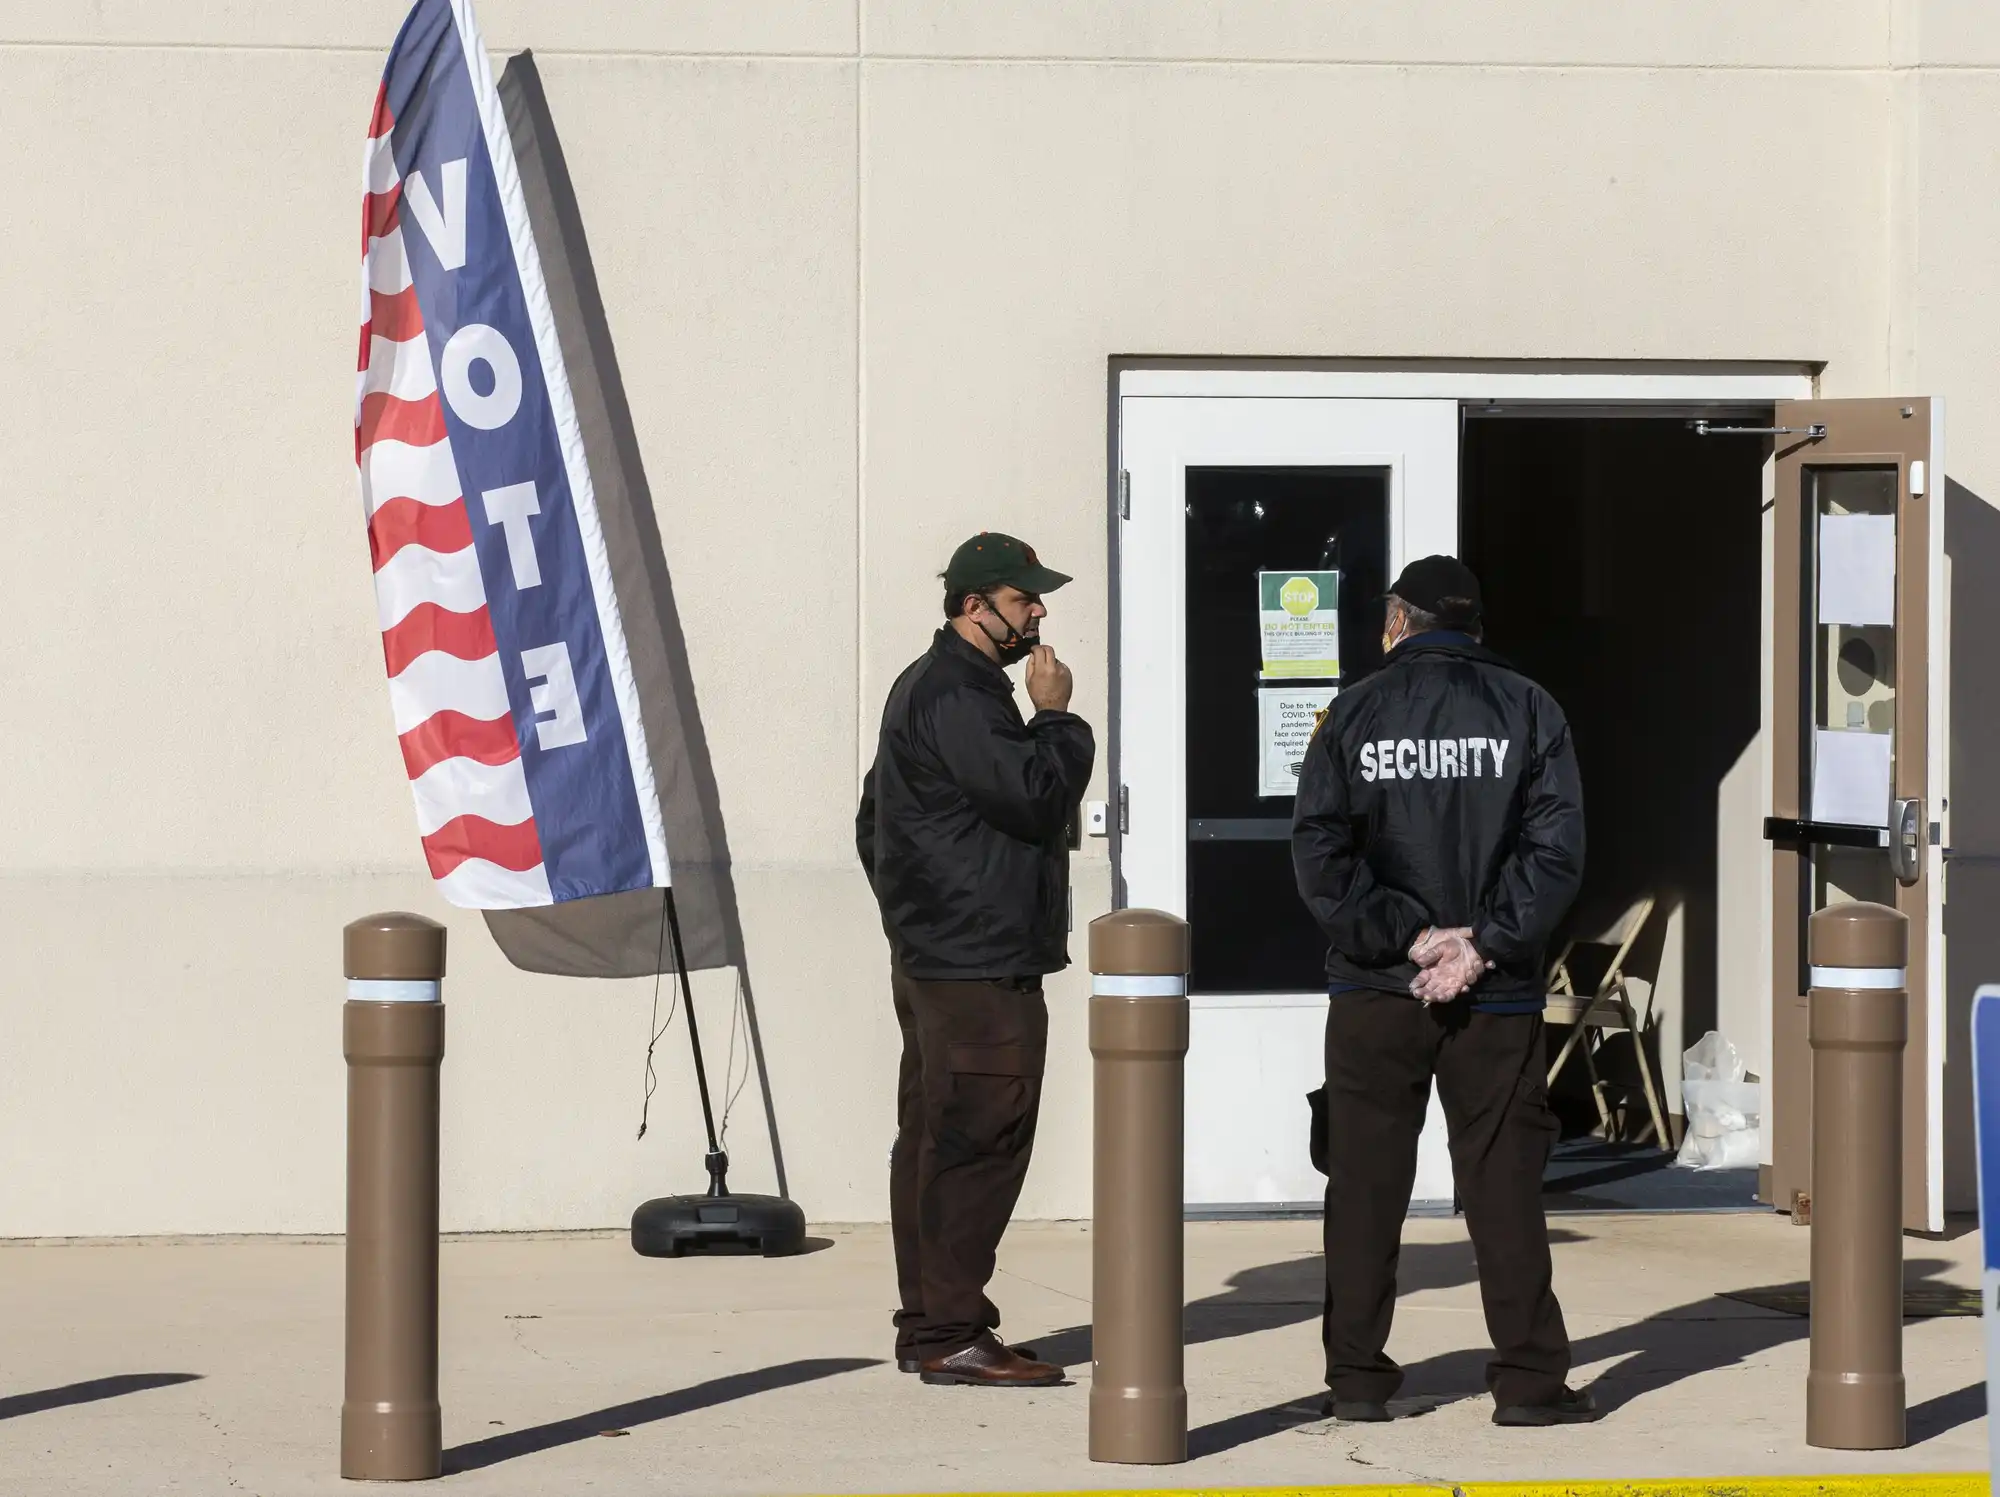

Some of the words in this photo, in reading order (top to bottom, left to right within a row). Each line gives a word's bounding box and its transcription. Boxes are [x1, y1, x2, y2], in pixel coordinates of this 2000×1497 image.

[1284, 591, 1315, 603] STOP
[1264, 623, 1277, 631] DO
[1280, 623, 1299, 631] NOT
[1303, 622, 1335, 630] ENTER
[1281, 711, 1315, 719] COVID-19
[1280, 721, 1315, 729] pandemic
[1273, 740, 1304, 748] required
[1360, 737, 1510, 782] SECURITY
